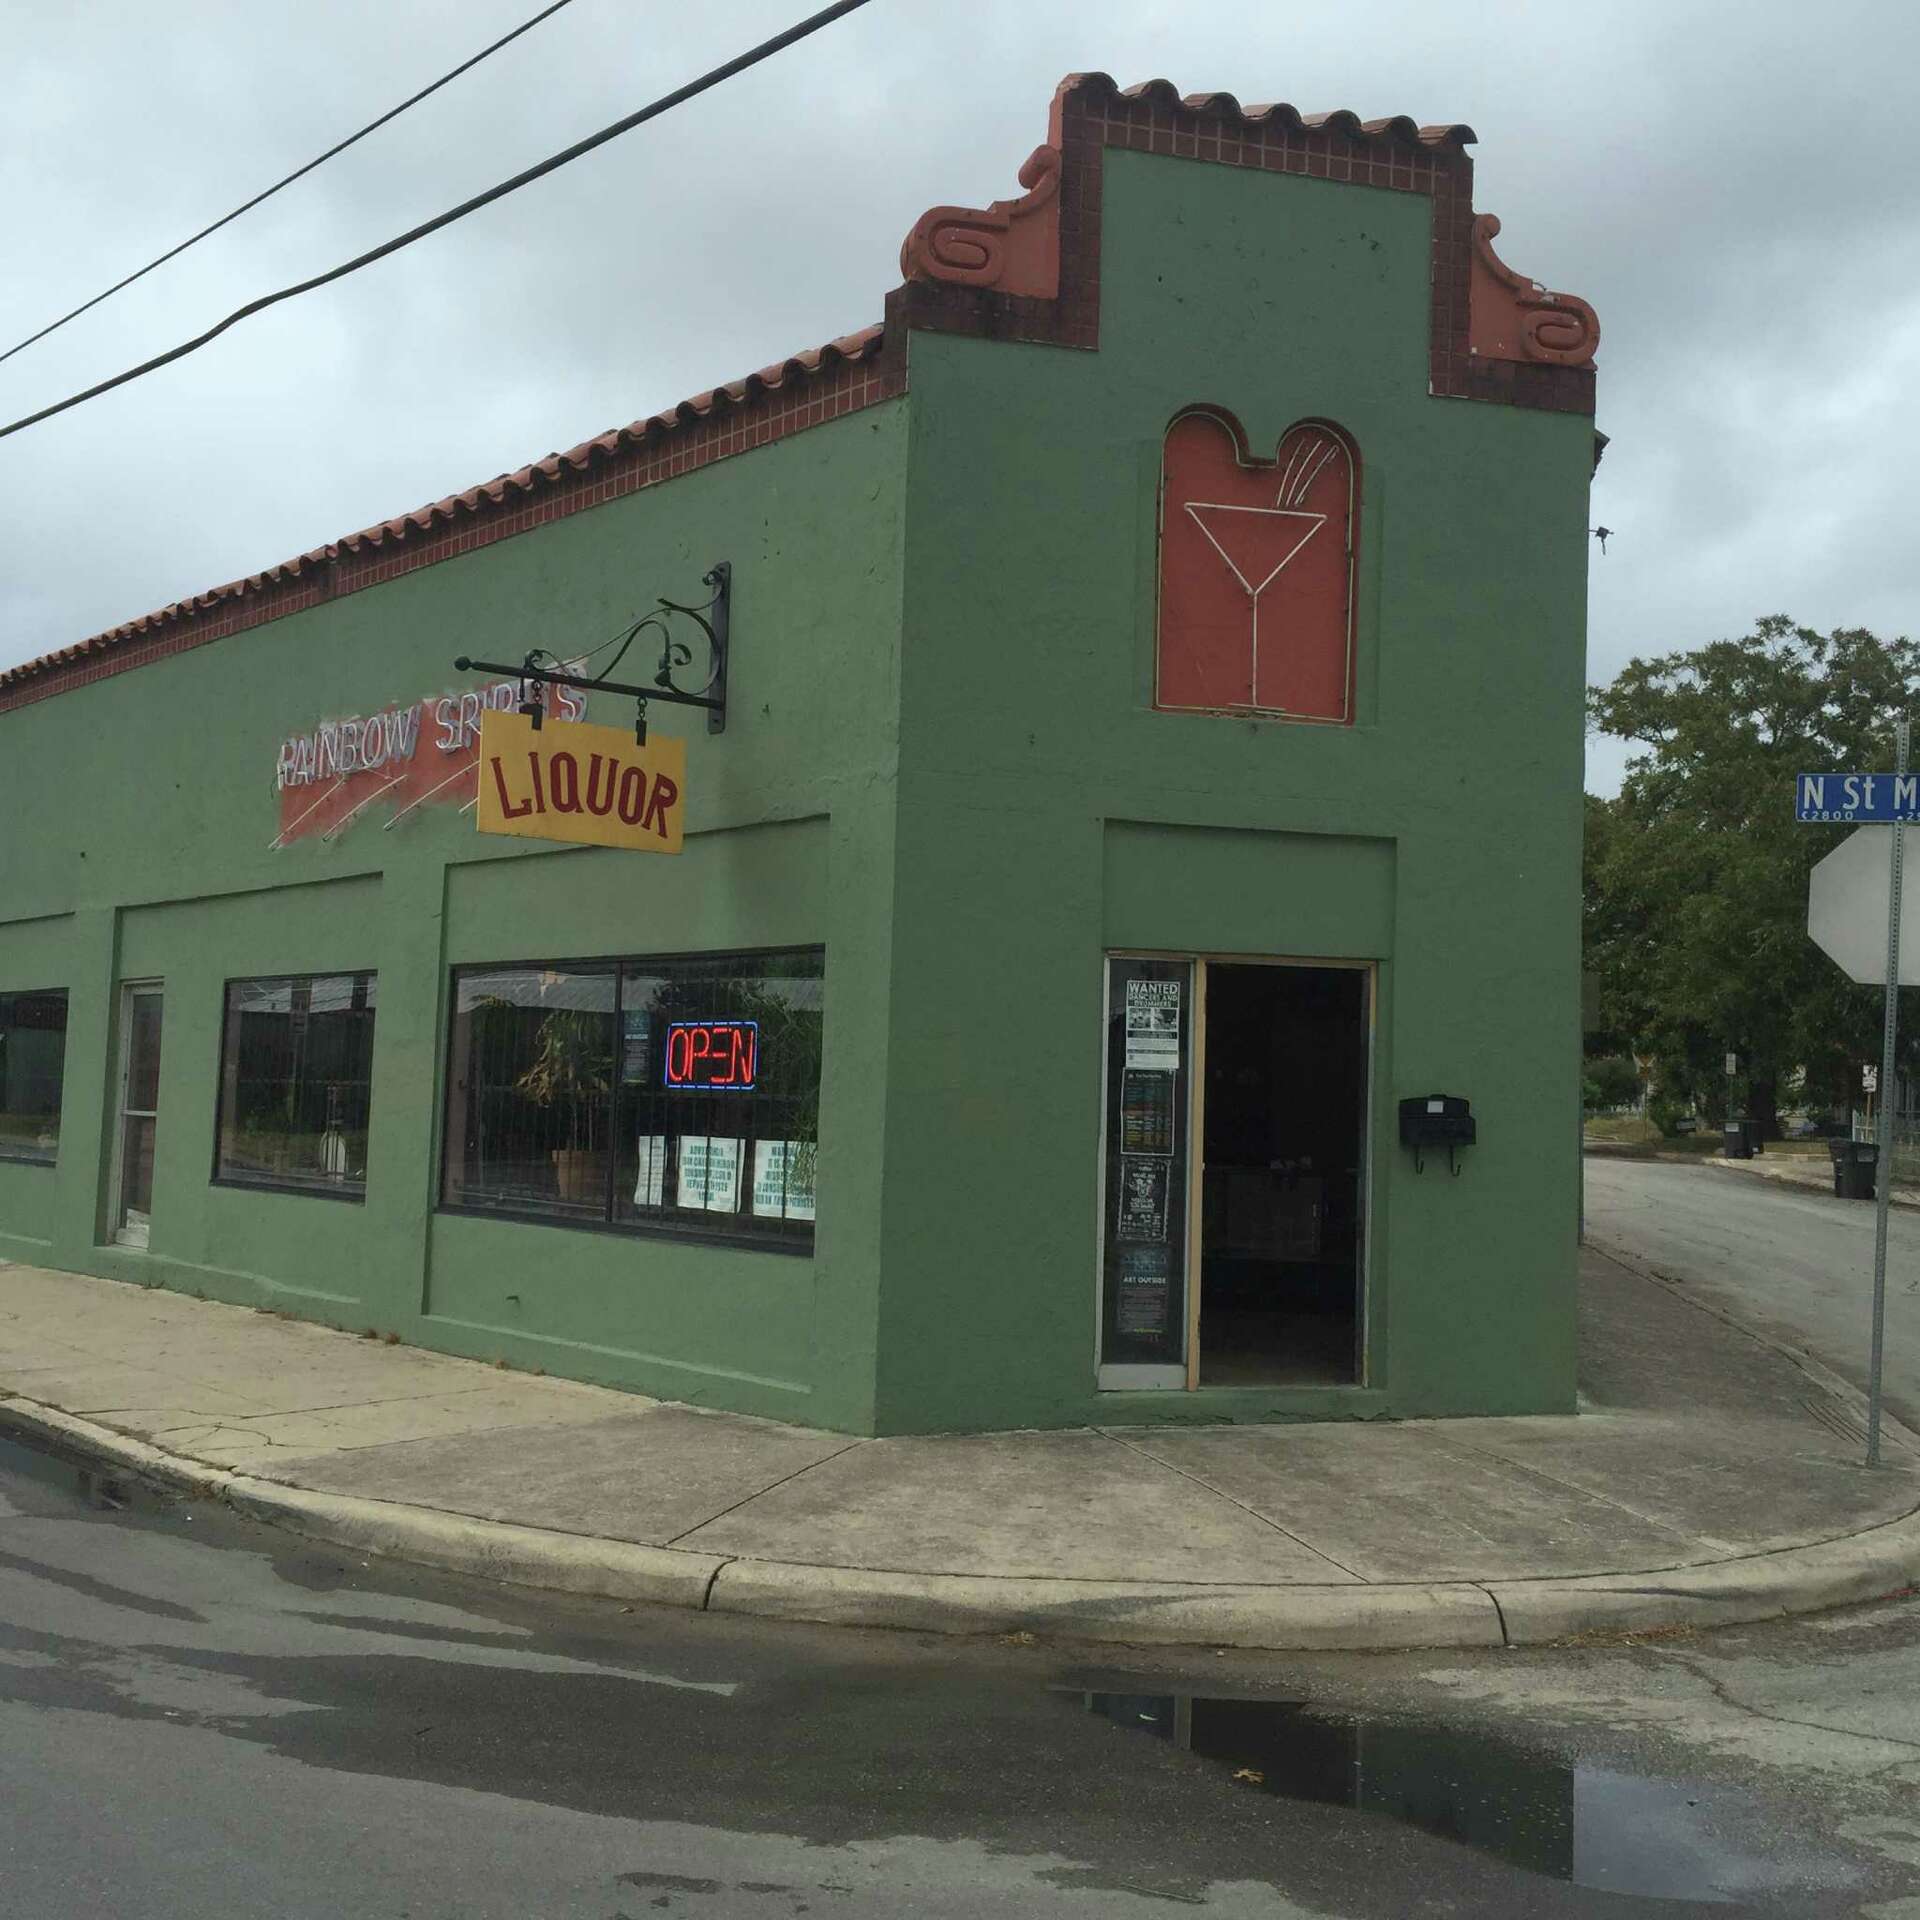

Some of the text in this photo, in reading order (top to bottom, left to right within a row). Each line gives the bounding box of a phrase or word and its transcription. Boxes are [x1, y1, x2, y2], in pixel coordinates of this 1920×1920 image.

[277, 704, 422, 791] RAINBOW
[490, 751, 679, 839] LIQUOR
[1804, 777, 1824, 809] N
[1843, 776, 1875, 810] St
[1129, 983, 1178, 994] WANTED
[1162, 993, 1178, 1001] AND
[669, 1028, 754, 1083] OPEN
